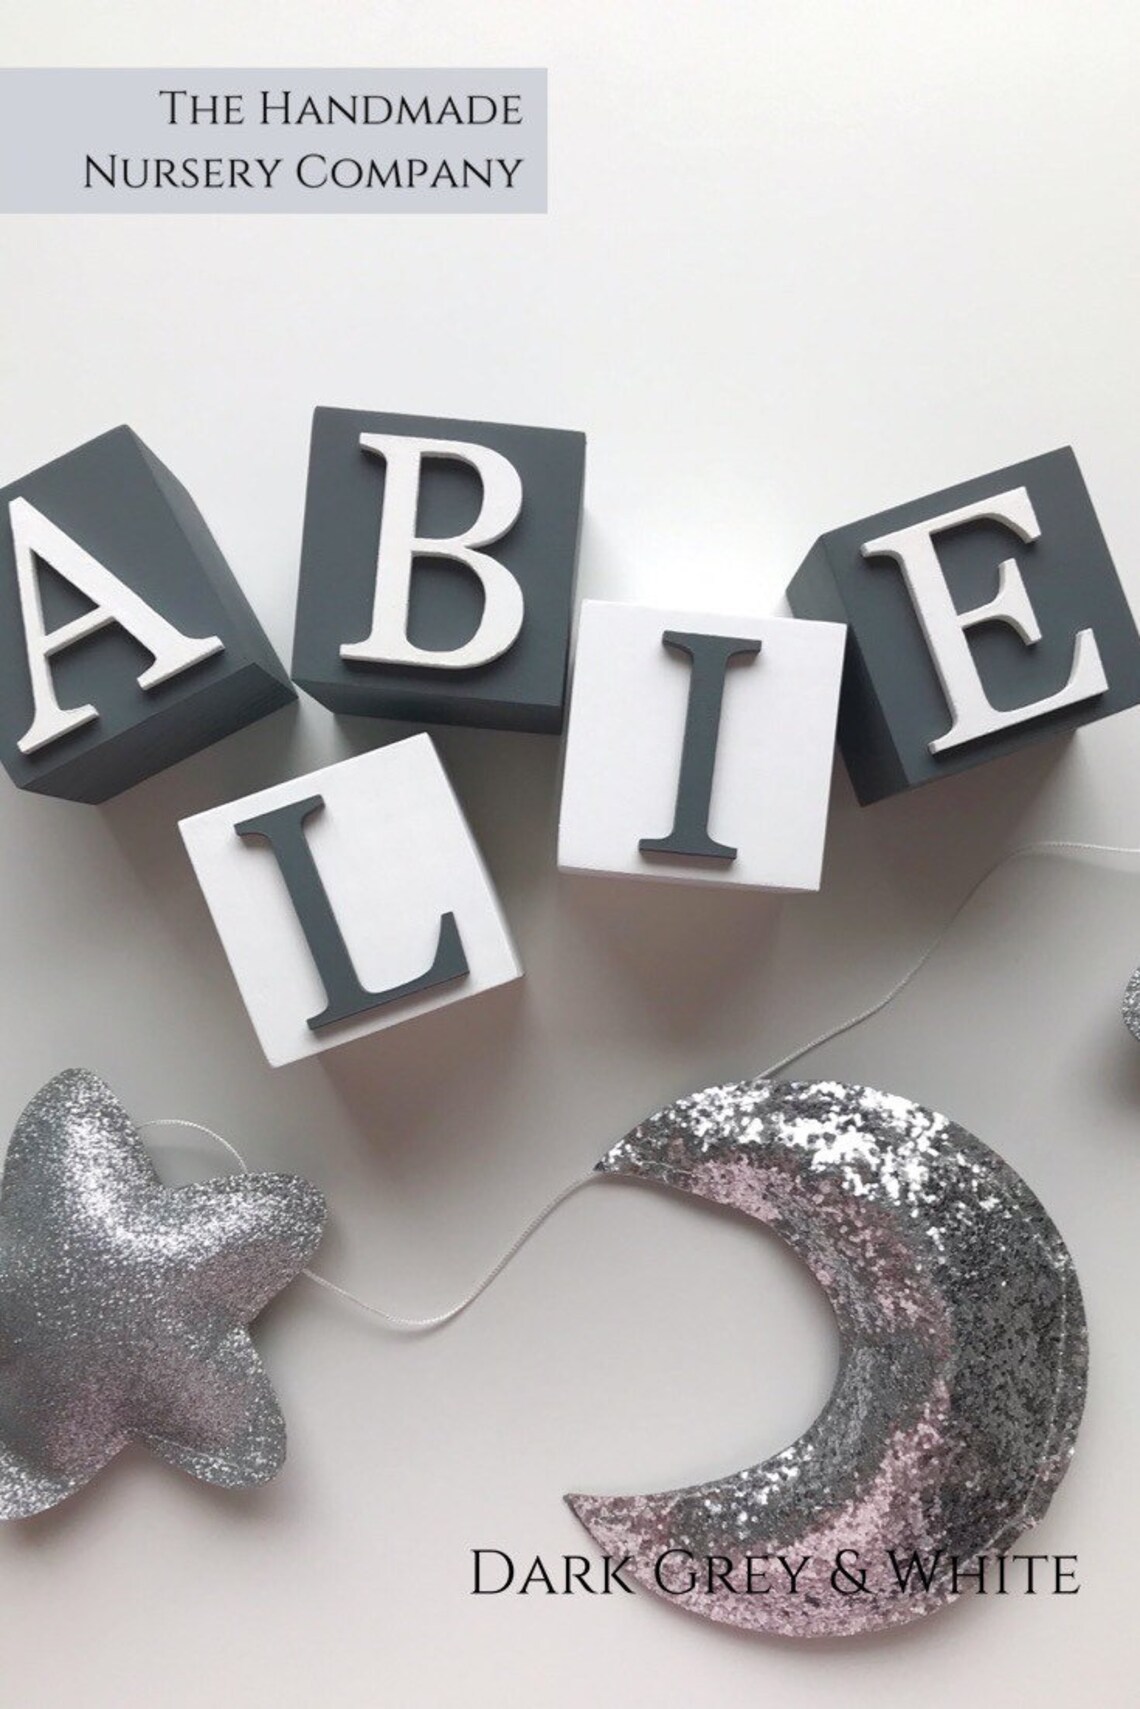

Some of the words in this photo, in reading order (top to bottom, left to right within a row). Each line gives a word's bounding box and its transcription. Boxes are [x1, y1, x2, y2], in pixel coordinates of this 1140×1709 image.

[8, 495, 227, 756] A
[339, 431, 525, 670] B
[860, 485, 1110, 755] E
[233, 793, 471, 1032] L
